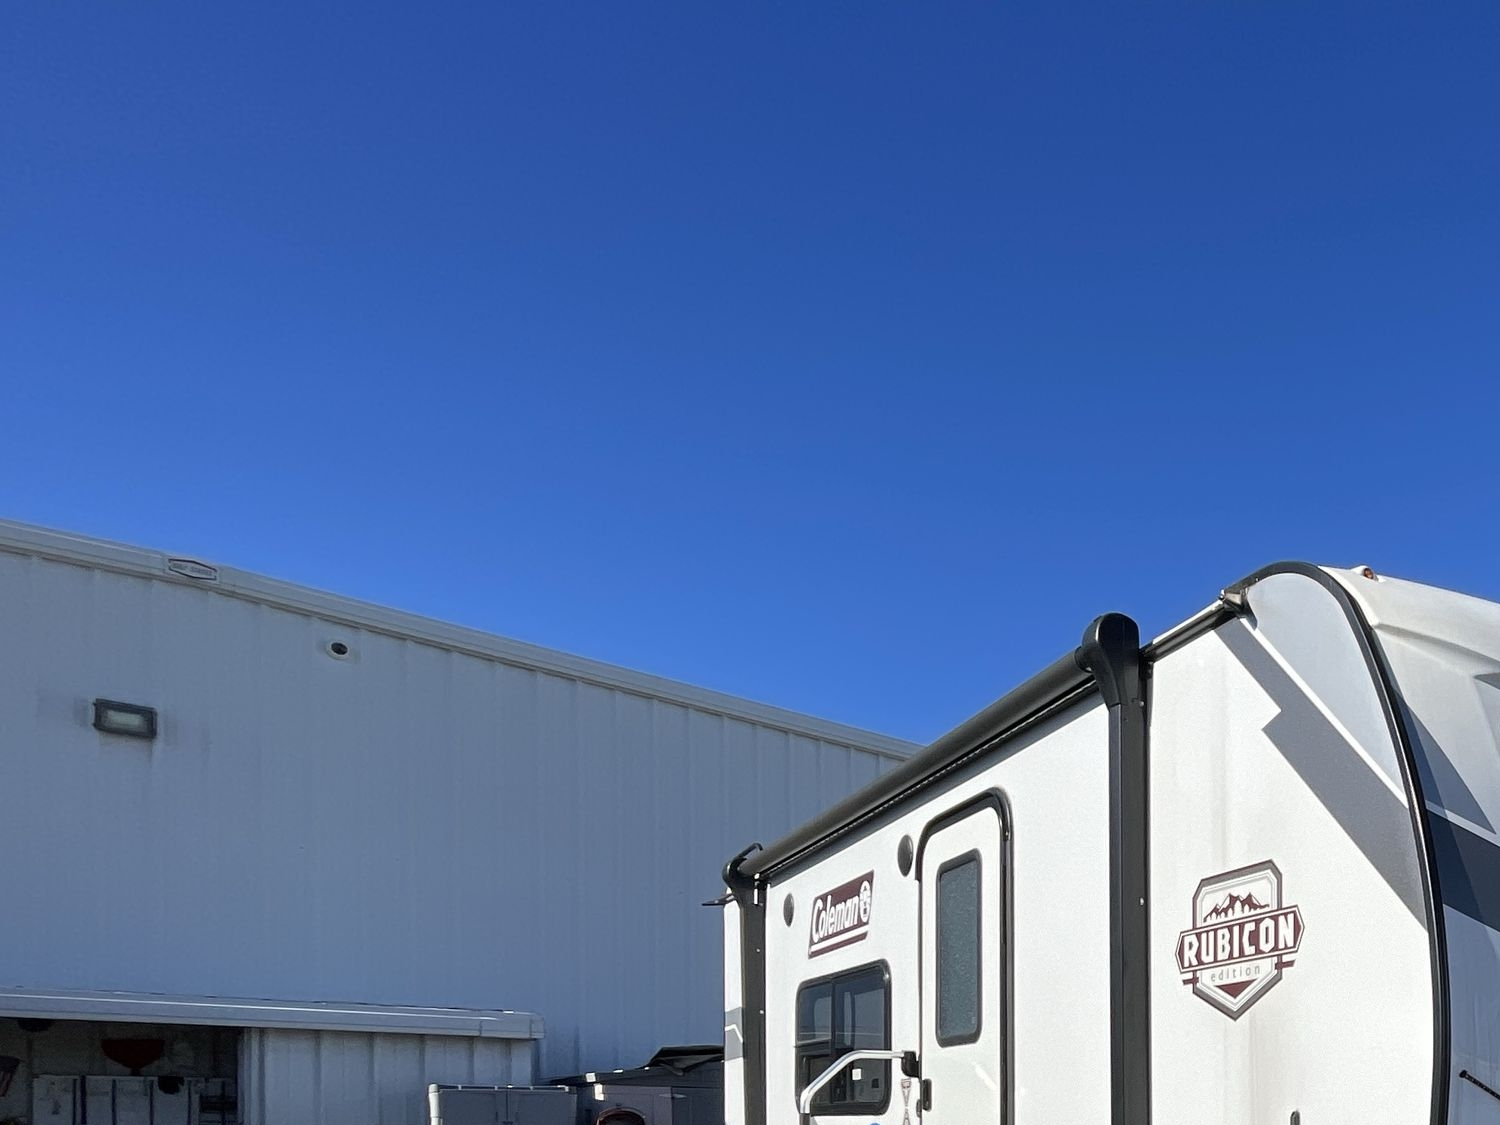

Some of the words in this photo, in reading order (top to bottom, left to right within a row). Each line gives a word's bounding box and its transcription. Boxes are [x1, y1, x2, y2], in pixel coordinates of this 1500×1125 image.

[812, 894, 859, 943] Coleman
[1183, 912, 1295, 968] RUBICON
[1210, 965, 1260, 982] edition
